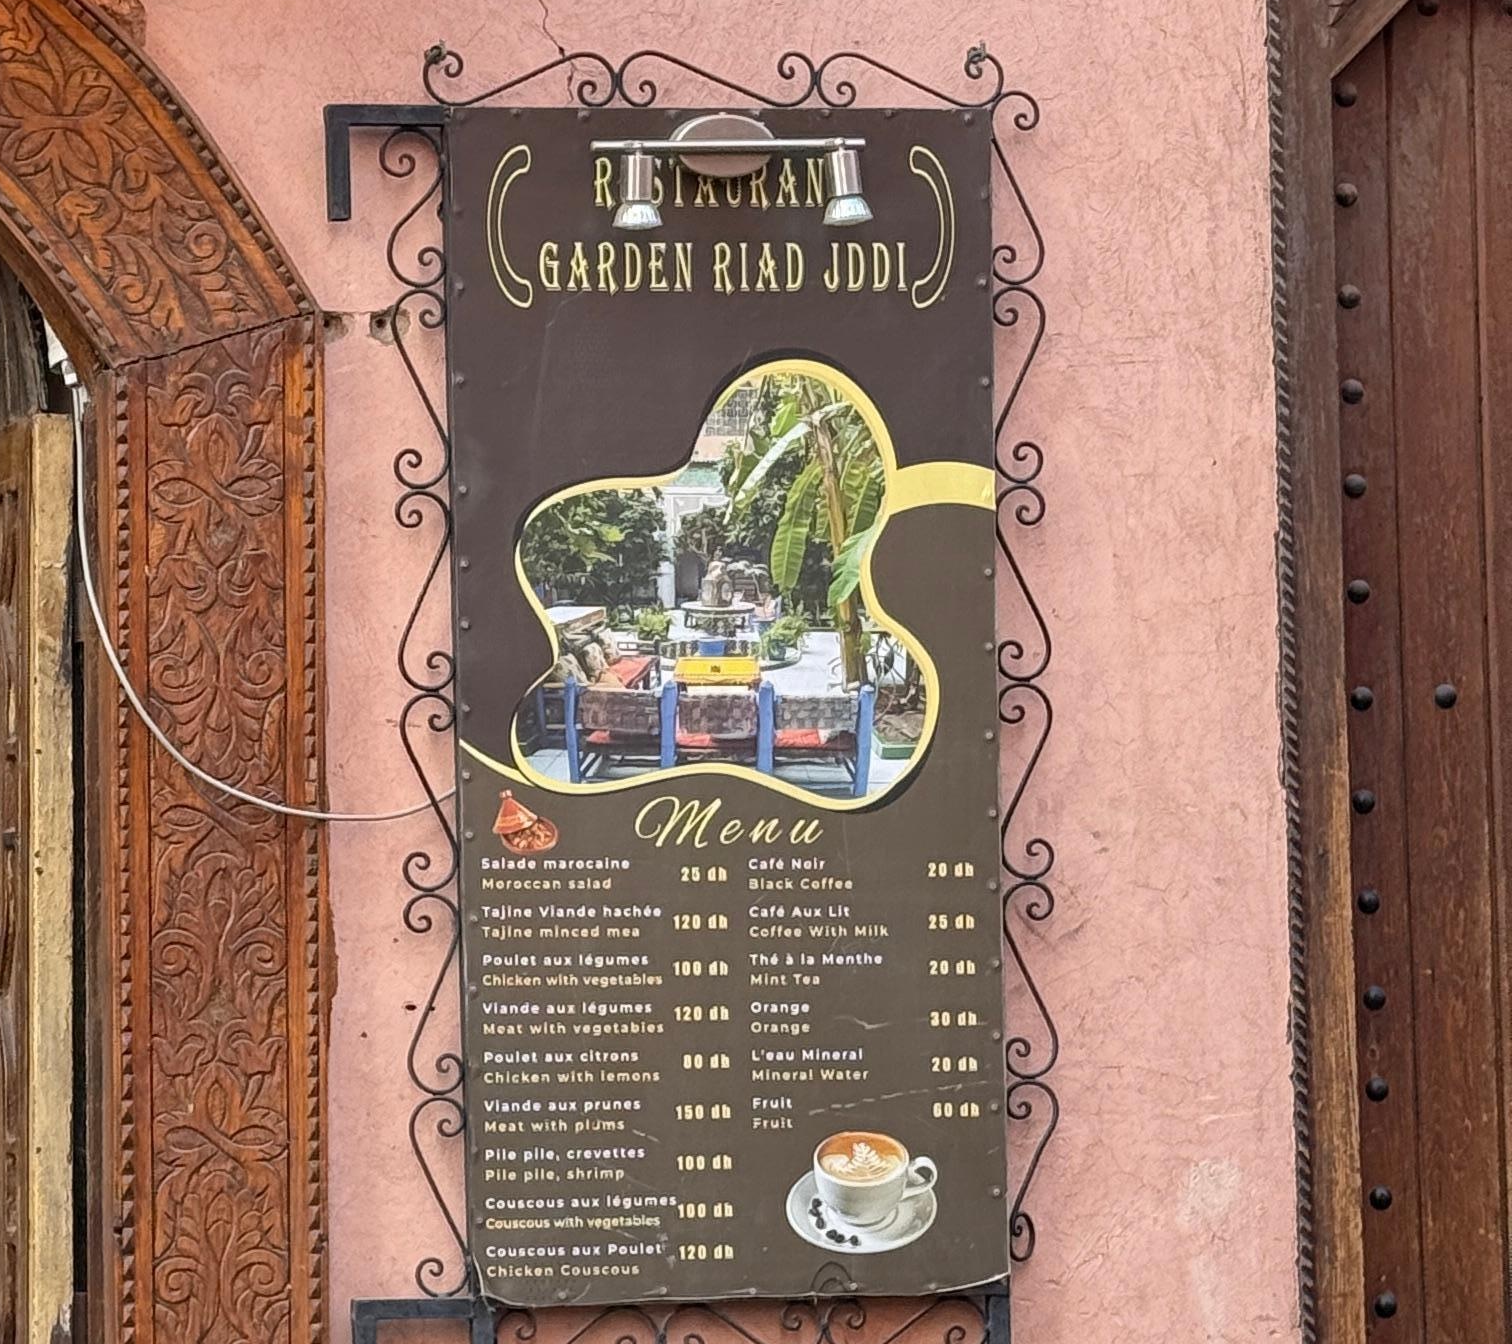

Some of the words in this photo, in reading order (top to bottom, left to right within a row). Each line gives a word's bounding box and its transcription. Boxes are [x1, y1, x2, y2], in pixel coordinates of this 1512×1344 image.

[539, 243, 692, 295] GARDEN
[714, 242, 804, 295] RIAD
[824, 242, 909, 293] JDDI
[635, 796, 824, 848] Menu
[482, 857, 536, 869] Salade
[544, 857, 629, 869] marocaine
[749, 858, 784, 869] Café
[792, 857, 825, 869] Noir
[483, 879, 561, 889] Moroccan
[569, 878, 611, 889] salad
[749, 878, 793, 889] Black
[800, 878, 852, 889] Coffee
[482, 905, 532, 920] Tajine
[539, 905, 596, 917] Viande
[749, 906, 784, 917] Café
[792, 907, 821, 917] Aux
[929, 915, 947, 929] 25
[482, 926, 532, 940] Tajine
[540, 925, 599, 937] minced
[750, 926, 801, 937] Coffee
[809, 925, 847, 937] With
[855, 925, 888, 936] Milk
[483, 954, 536, 966] Poulet
[544, 957, 571, 965] aux
[579, 954, 648, 967] légumes
[750, 953, 778, 965] Thé
[801, 953, 814, 965] la
[823, 953, 882, 964] Menthe
[483, 974, 541, 986] Chicken
[546, 974, 578, 985] with
[583, 974, 662, 987] vegetables
[751, 973, 786, 985] Mint
[793, 974, 819, 985] Tea
[483, 1002, 539, 1014] Viande
[547, 1005, 575, 1014] aux
[583, 1002, 651, 1016] légumes
[751, 1002, 809, 1015] Orange
[931, 1012, 950, 1026] 30
[484, 1024, 522, 1034] Meat
[530, 1022, 566, 1034] with
[573, 1022, 663, 1036] vegetables
[751, 1022, 809, 1035] Orange
[484, 1051, 537, 1063] Poulet
[545, 1053, 572, 1062] aux
[580, 1050, 638, 1062] citrons
[802, 1048, 862, 1060] Mineral
[484, 1071, 550, 1083] Chicken
[557, 1071, 593, 1082] with
[601, 1070, 659, 1082] lemons
[752, 1069, 813, 1080] Mineral
[821, 1069, 868, 1080] Water
[484, 1100, 541, 1112] Viande
[549, 1102, 576, 1111] aux
[584, 1101, 640, 1113] prunes
[753, 1097, 792, 1109] Fruit
[485, 1121, 524, 1132] Meat
[531, 1119, 567, 1131] with
[575, 1119, 624, 1133] plums
[753, 1117, 792, 1128] Fruit
[567, 1148, 644, 1159] crevettes
[567, 1167, 624, 1181] shrimp
[486, 1198, 564, 1209] Couscous
[571, 1199, 599, 1207] aux
[607, 1195, 676, 1209] légumes
[486, 1218, 550, 1229] Couscous
[554, 1216, 583, 1227] with
[587, 1215, 660, 1230] vegetables
[486, 1246, 565, 1257] Couscous
[572, 1247, 600, 1255] aux
[608, 1243, 661, 1255] Poulet
[487, 1265, 553, 1277] Chicken
[561, 1265, 639, 1276] Couscous
